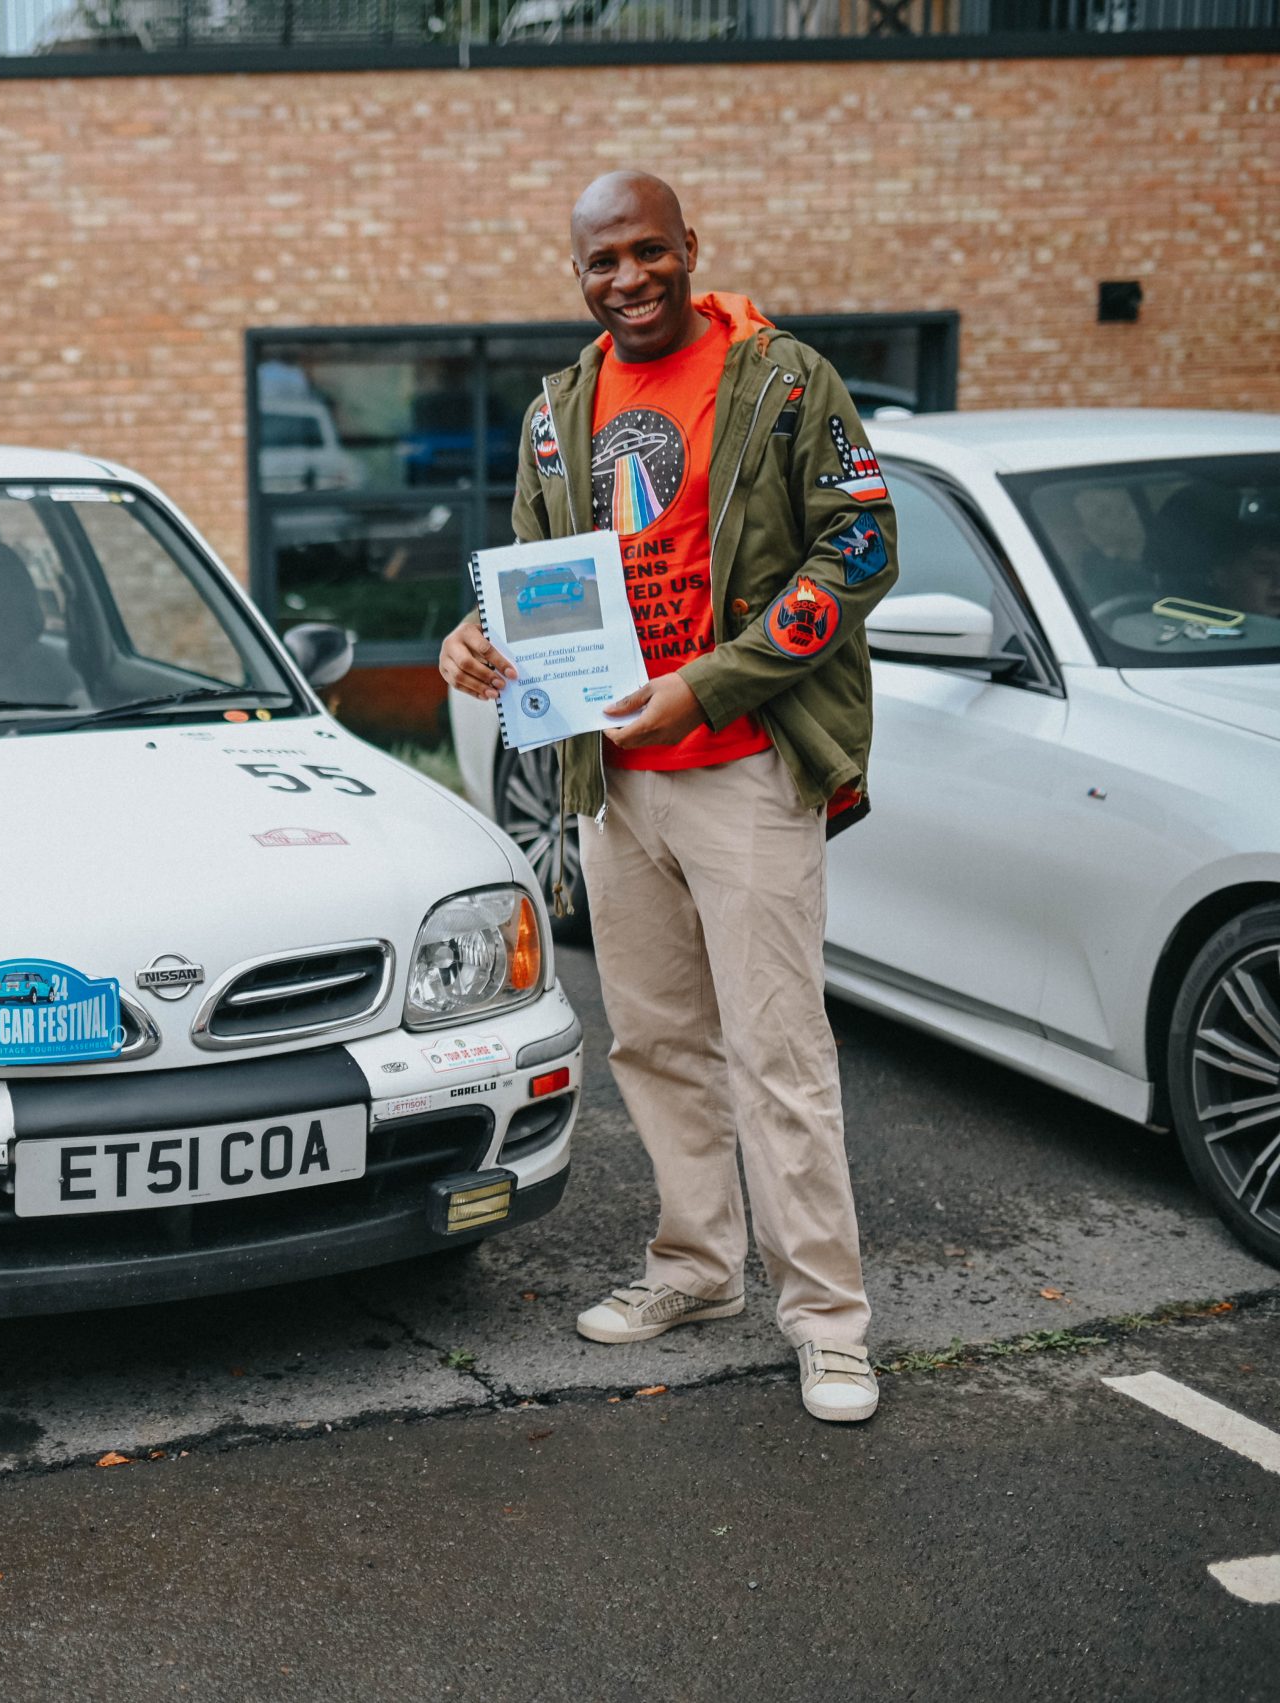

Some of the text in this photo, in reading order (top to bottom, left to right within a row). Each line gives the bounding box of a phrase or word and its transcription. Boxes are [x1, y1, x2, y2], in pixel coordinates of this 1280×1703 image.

[624, 537, 676, 560] GINE
[624, 560, 669, 580] ENS
[670, 573, 705, 594] US
[636, 617, 694, 641] REAT
[515, 642, 605, 663] StreetCar Festival Touring
[543, 655, 576, 666] Assembly
[518, 675, 541, 687] Sunday
[553, 668, 589, 680] September
[235, 763, 377, 797] 55
[144, 968, 197, 983] NISSAN
[38, 993, 109, 1044] FESTIVAL
[30, 1044, 67, 1053] TOURING
[70, 1041, 109, 1051] ASSEMBLY
[450, 1081, 497, 1097] CARELLO
[392, 1100, 427, 1112] JETTISON
[60, 1119, 331, 1202] ET51 COA
